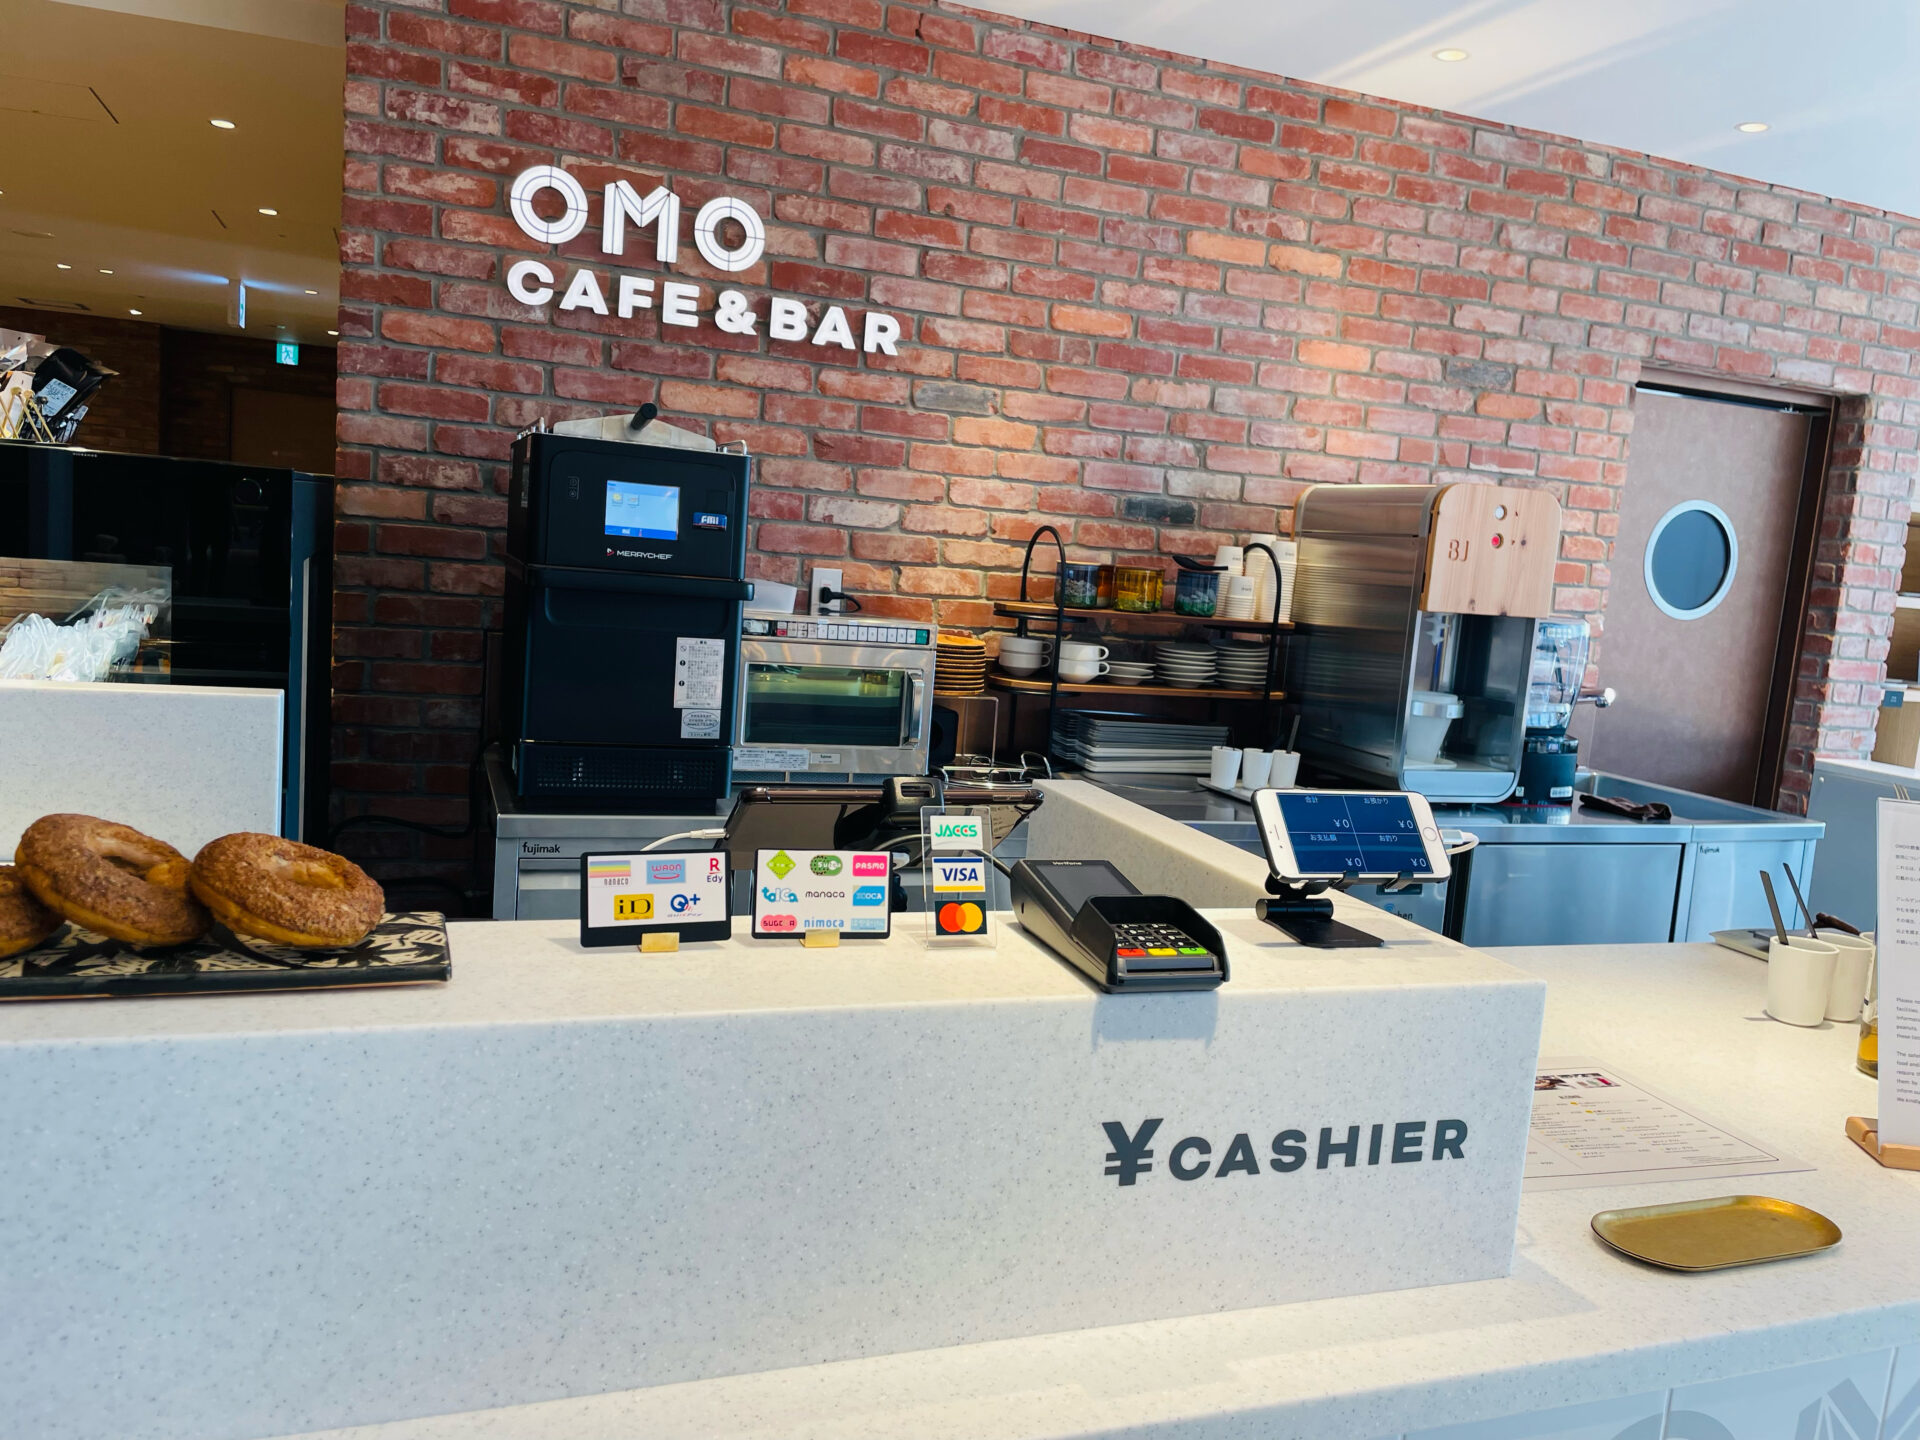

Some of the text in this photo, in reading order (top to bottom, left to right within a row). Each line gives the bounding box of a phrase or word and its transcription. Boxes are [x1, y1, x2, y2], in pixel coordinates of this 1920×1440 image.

[510, 164, 766, 272] OMO
[507, 260, 901, 356] CAFE&BAR
[617, 550, 672, 560] MERRYCHEF
[935, 824, 978, 838] JACCS
[522, 842, 560, 855] fujimak
[651, 863, 682, 872] WAON
[855, 862, 885, 870] PASMO
[706, 875, 723, 884] Edy
[940, 867, 979, 882] VISA
[804, 917, 844, 928] nimoca
[1168, 1119, 1469, 1181] CASHIER
